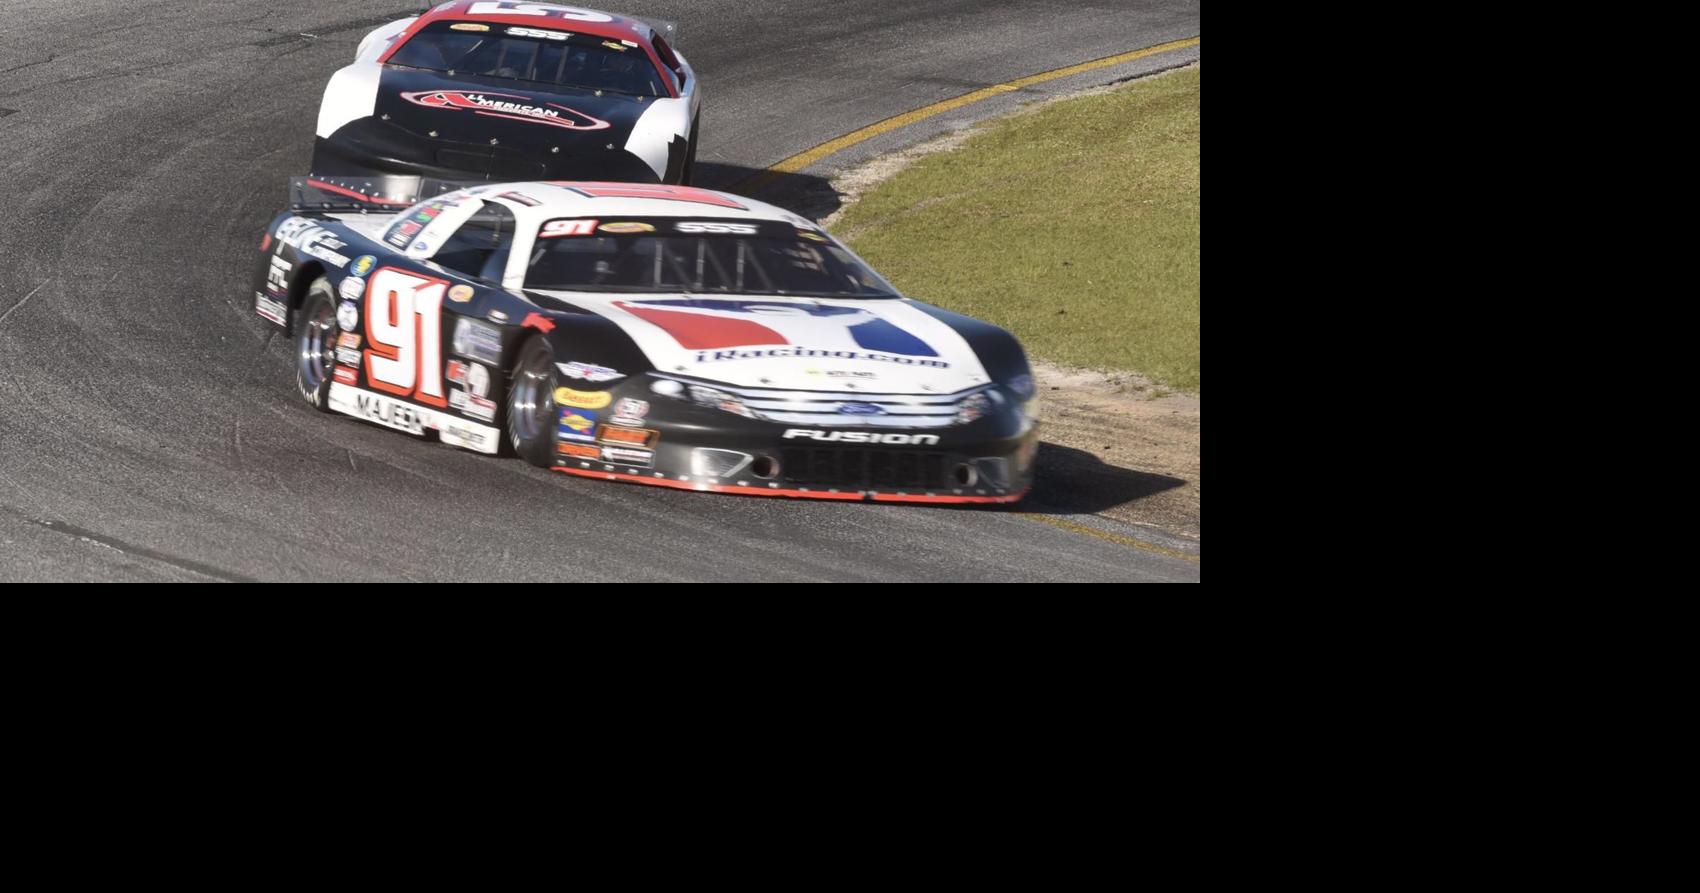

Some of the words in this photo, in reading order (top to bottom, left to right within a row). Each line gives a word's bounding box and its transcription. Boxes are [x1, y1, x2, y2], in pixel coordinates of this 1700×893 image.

[505, 26, 574, 41] SSS
[538, 219, 599, 238] 91
[674, 221, 760, 235] SSS
[363, 266, 450, 408] 91
[696, 347, 952, 368] iRacing.com
[782, 428, 941, 446] FUSION
